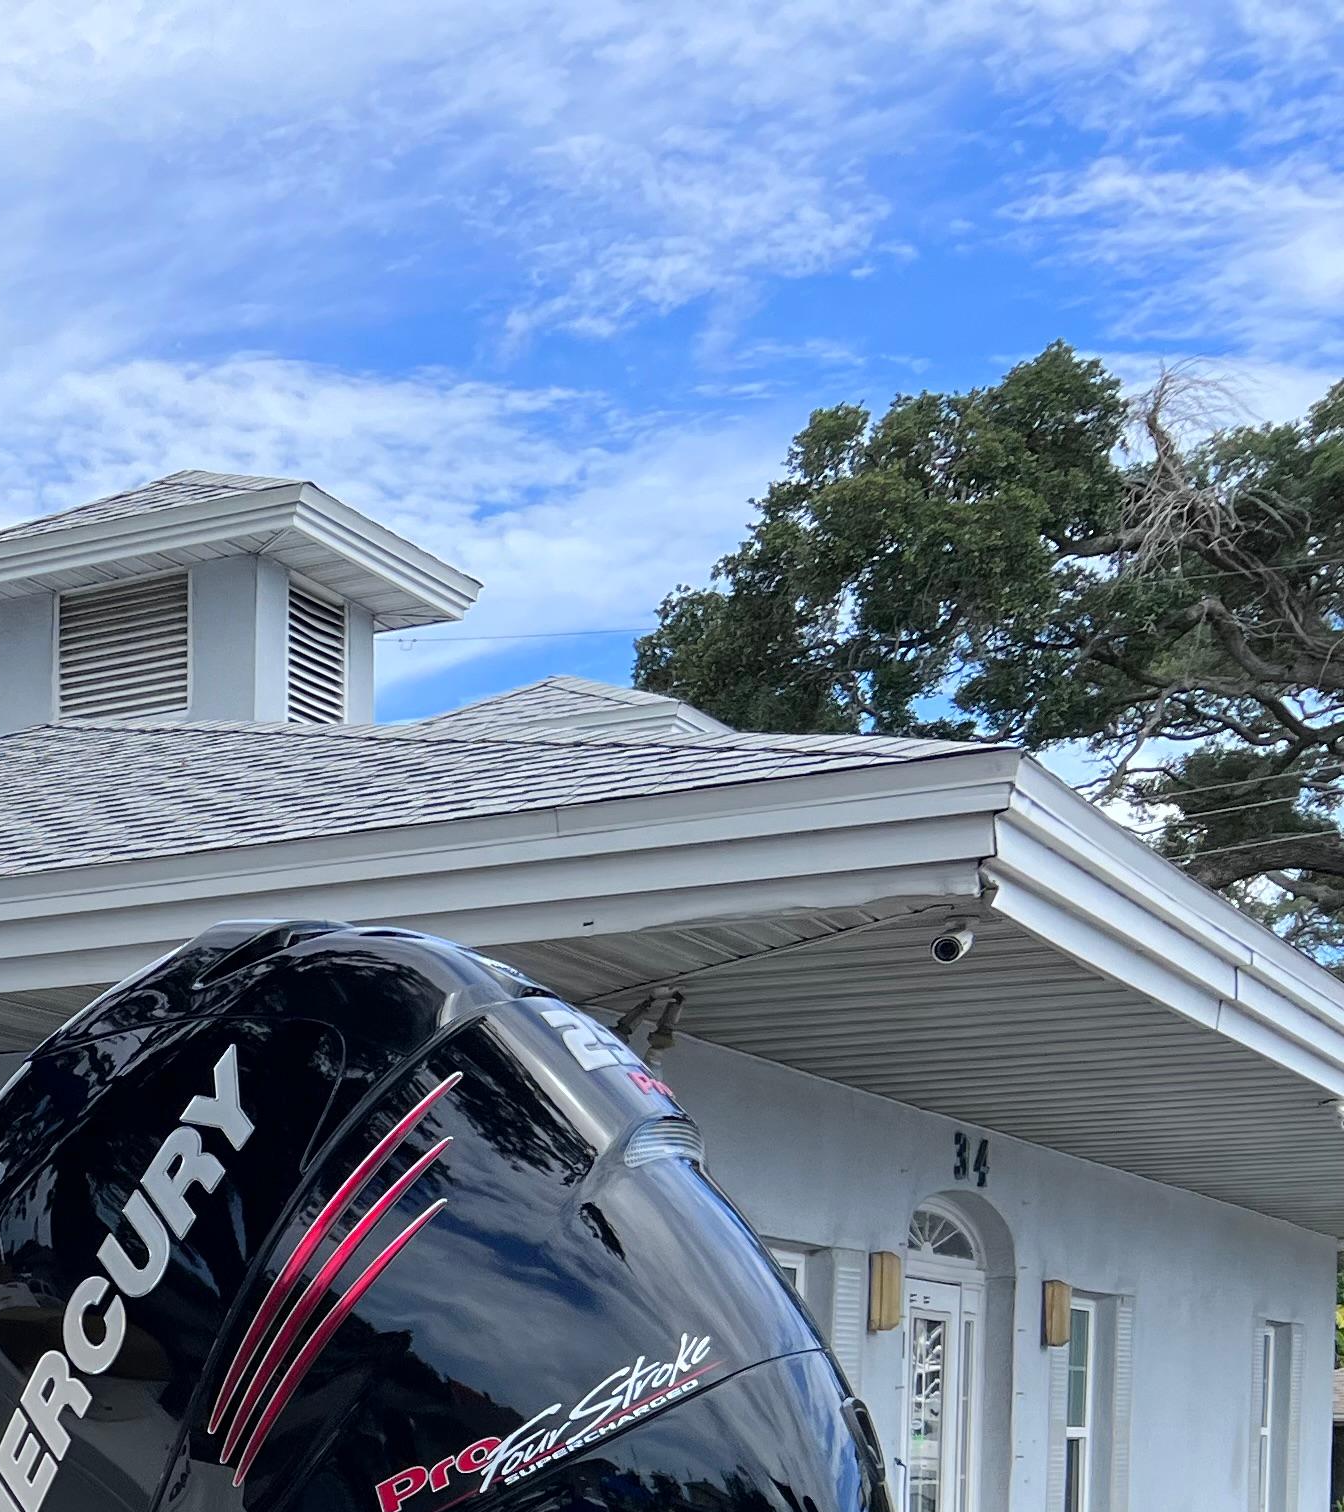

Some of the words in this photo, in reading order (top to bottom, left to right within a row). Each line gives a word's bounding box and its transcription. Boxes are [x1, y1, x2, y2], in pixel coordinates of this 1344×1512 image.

[953, 1131, 990, 1187] 34
[478, 1403, 572, 1494] Four
[568, 1332, 711, 1442] Stroke
[504, 1379, 699, 1486] SUPERCHARGED
